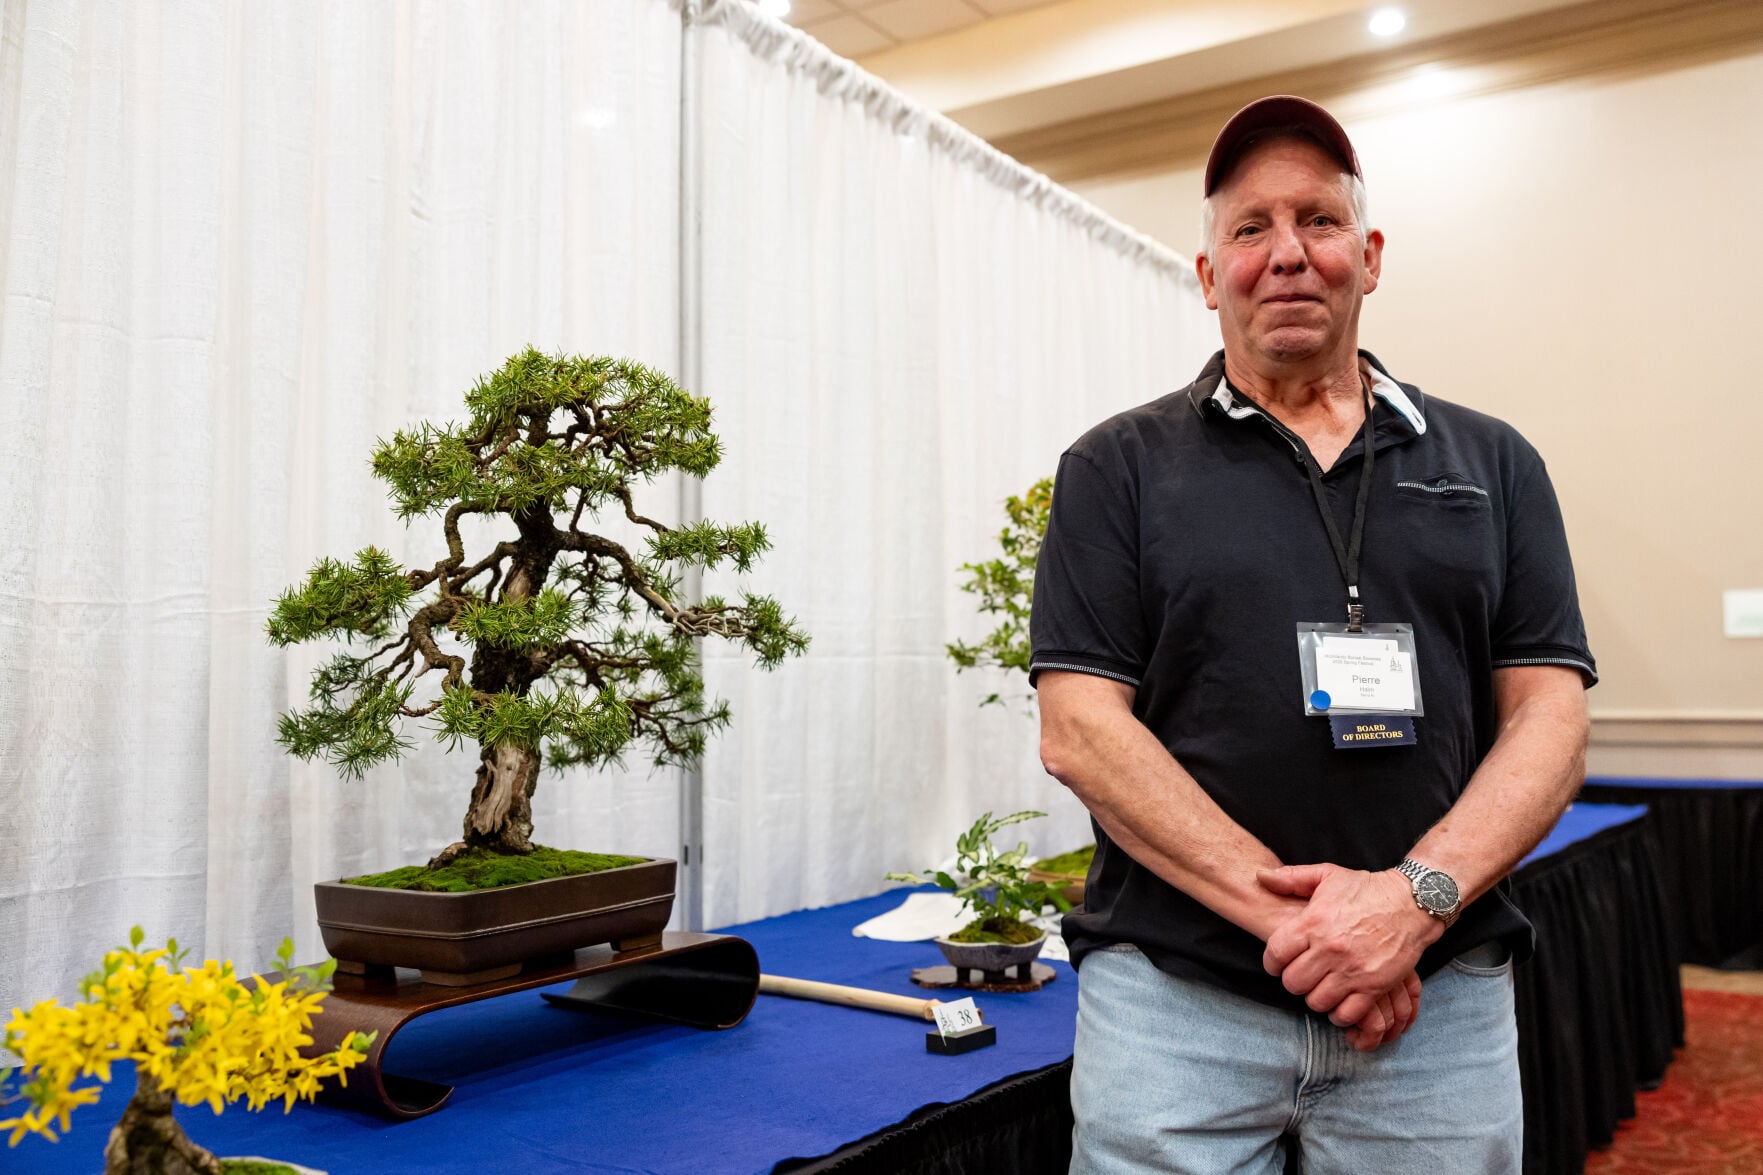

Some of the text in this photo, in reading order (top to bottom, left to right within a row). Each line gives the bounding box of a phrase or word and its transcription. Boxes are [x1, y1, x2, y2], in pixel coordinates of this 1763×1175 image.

[1352, 674, 1381, 685] Pierre
[1356, 724, 1386, 732] BOARD
[1342, 731, 1403, 741] OF DIRECTORS
[957, 1008, 973, 1026] 38
